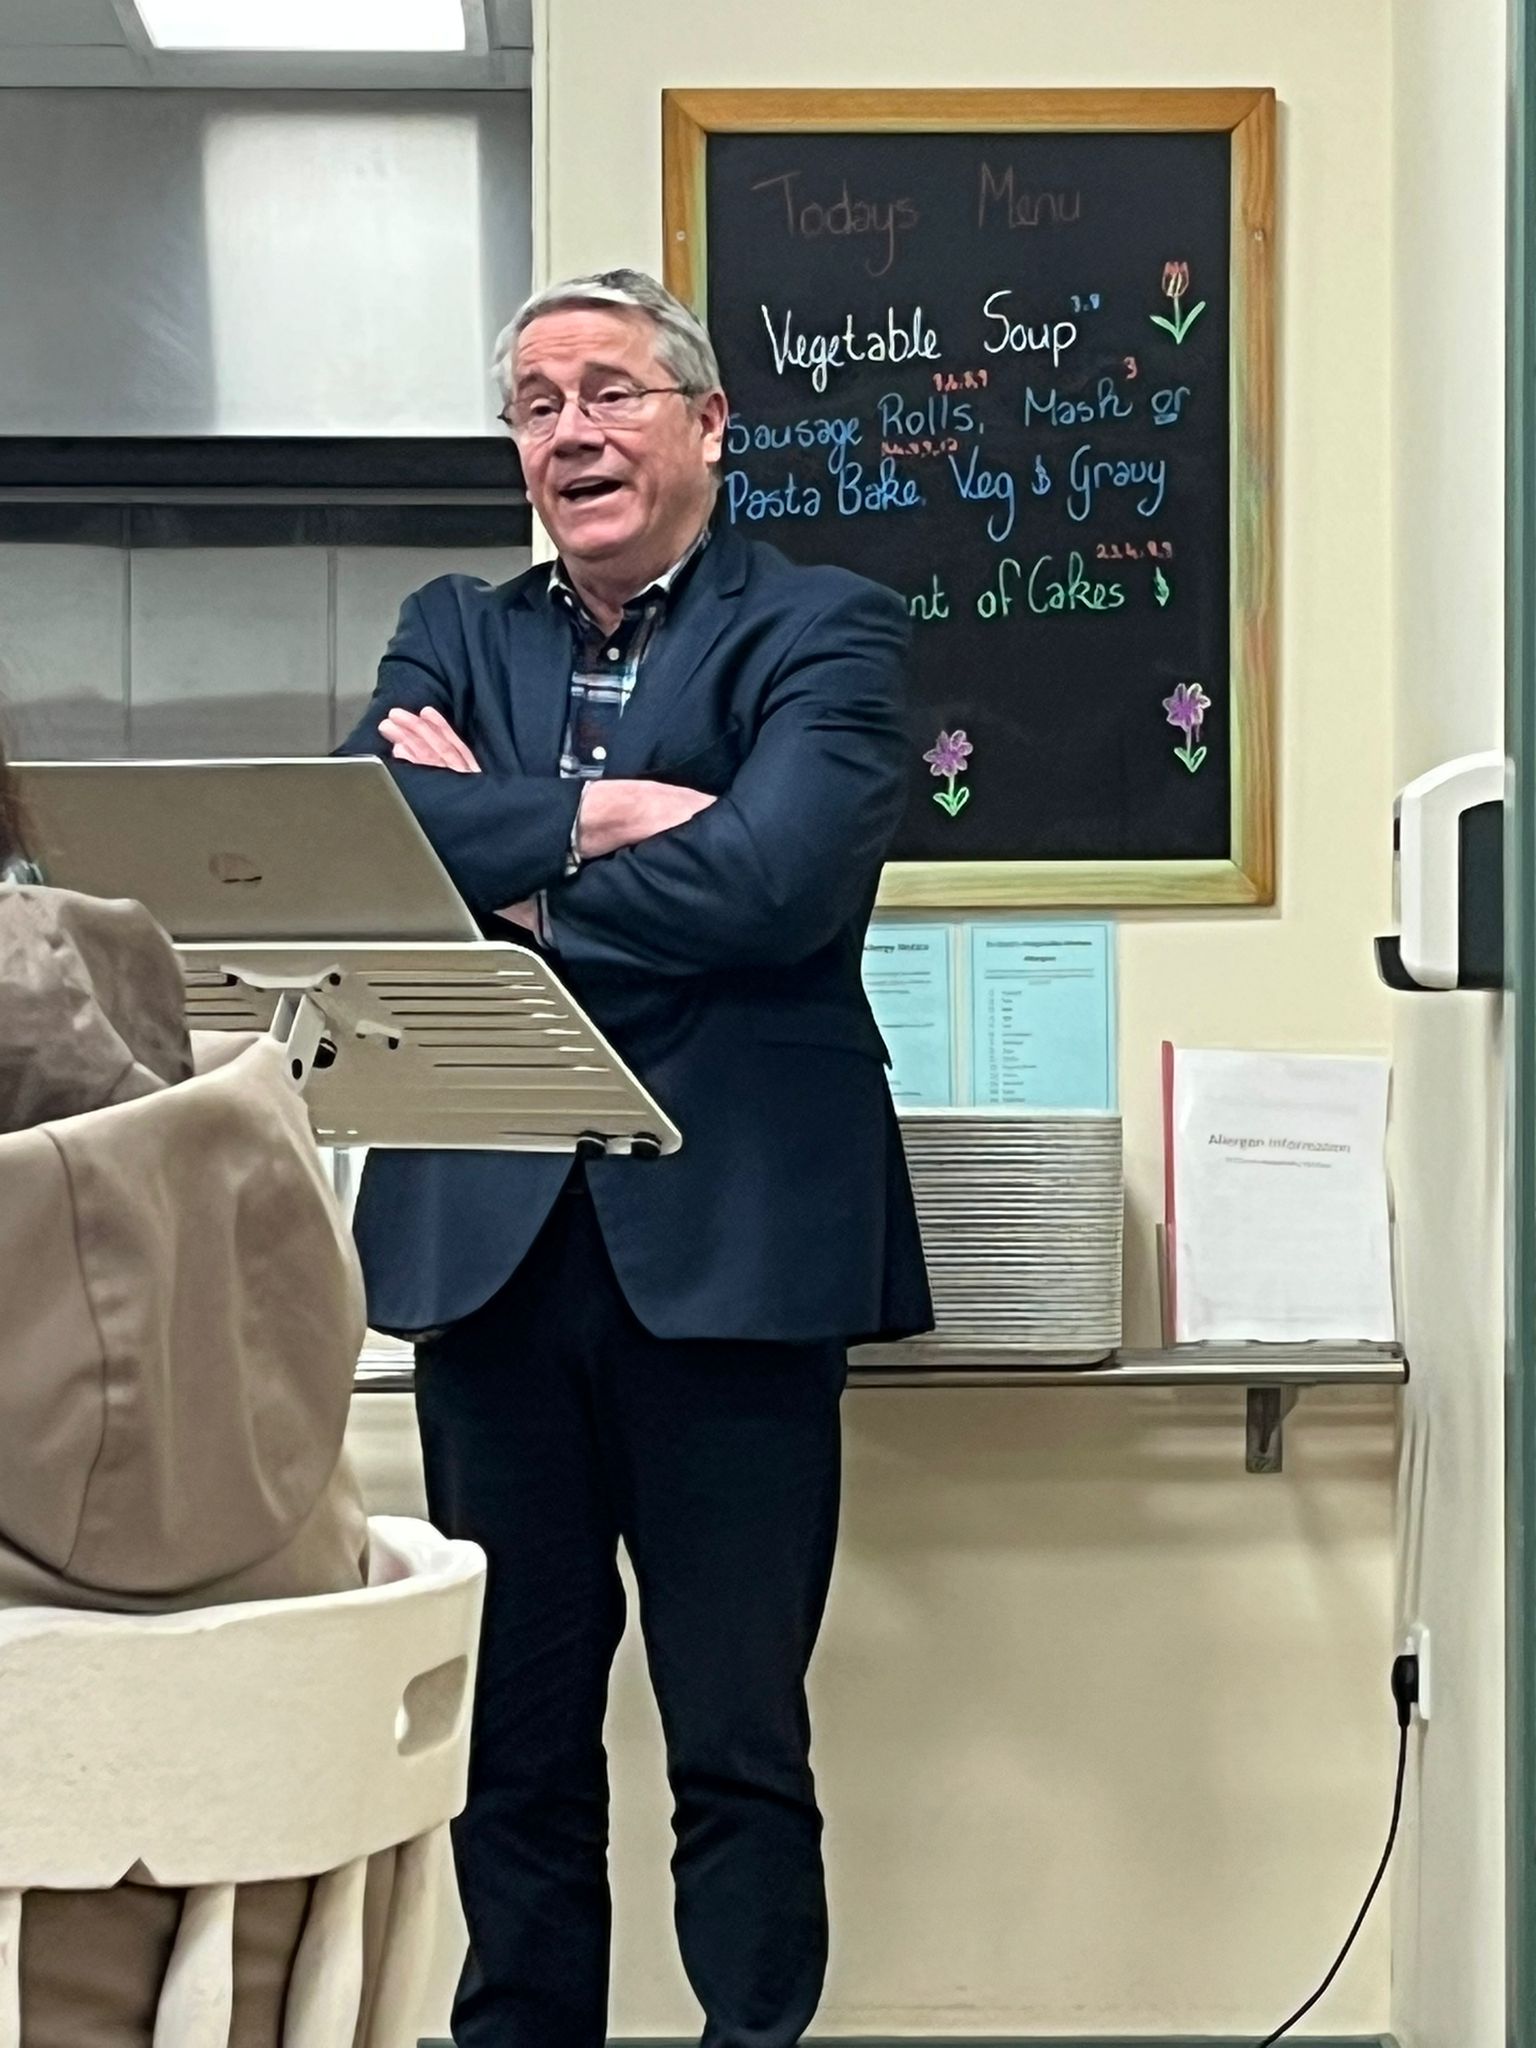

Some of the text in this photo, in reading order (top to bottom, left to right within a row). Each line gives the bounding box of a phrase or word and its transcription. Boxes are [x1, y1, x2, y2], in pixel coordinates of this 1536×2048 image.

[752, 161, 1081, 277] Todays Menu
[761, 289, 1077, 392] Vegetable Soup
[727, 413, 863, 475] Sausage
[1024, 377, 1133, 427] Mash
[1151, 386, 1191, 426] or
[725, 470, 821, 525] Pasta
[948, 445, 1016, 542] Veg
[1066, 444, 1166, 522] Gravy
[977, 558, 1021, 619] of
[1028, 550, 1125, 614] Cakes
